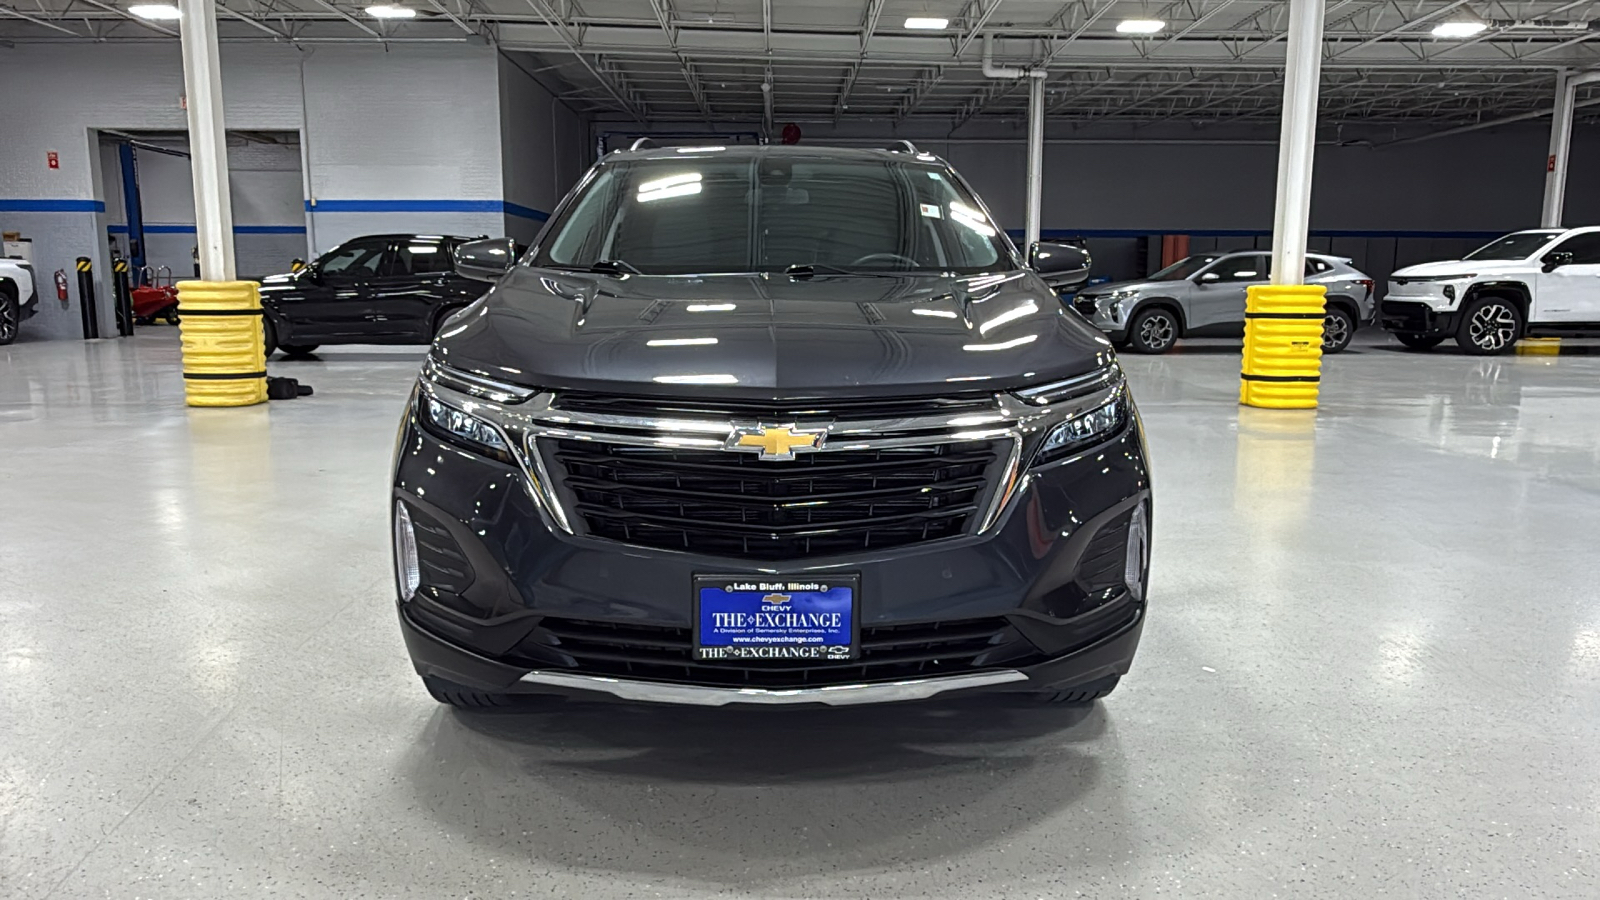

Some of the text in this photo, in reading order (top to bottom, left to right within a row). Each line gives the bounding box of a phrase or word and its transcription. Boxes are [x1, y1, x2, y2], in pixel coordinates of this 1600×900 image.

[734, 583, 757, 591] Lake
[760, 582, 785, 591] Bluff,
[712, 612, 842, 628] THE EXCHANGE
[732, 636, 824, 644] www.chevyexchange.com
[699, 646, 820, 658] THE EXCHANGE
